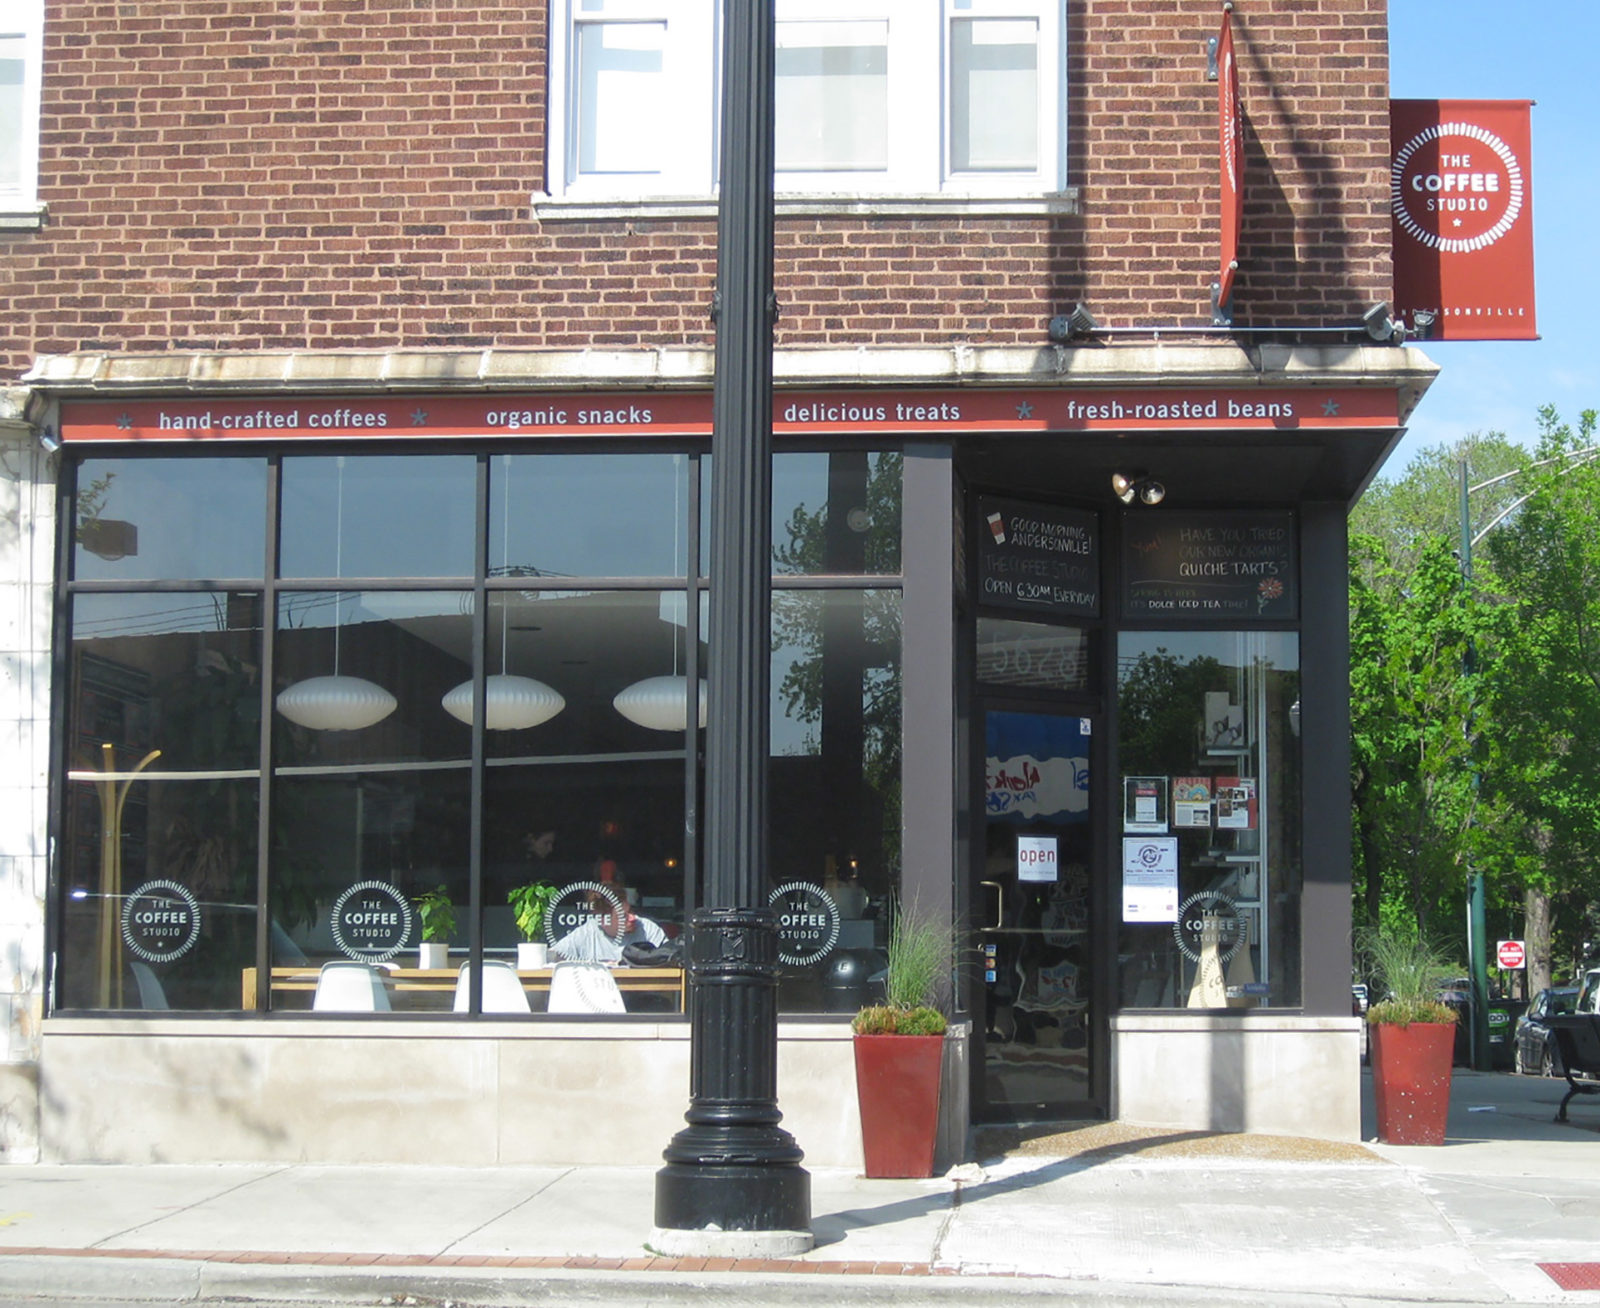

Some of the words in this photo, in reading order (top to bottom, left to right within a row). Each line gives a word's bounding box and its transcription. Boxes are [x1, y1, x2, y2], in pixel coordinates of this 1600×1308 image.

[1441, 154, 1471, 168] THE
[1412, 173, 1499, 192] COFFEE
[1426, 198, 1489, 211] STUDIO
[784, 402, 887, 423] delicious
[896, 401, 961, 421] treats
[1067, 399, 1219, 420] fresh-roasted
[1228, 399, 1294, 418] beans
[158, 409, 299, 431] hand-crafted
[308, 408, 388, 428] coffees
[486, 406, 568, 429] organic
[577, 405, 653, 425] snacks
[1180, 528, 1217, 542] HAVE
[1220, 528, 1245, 542] YOU
[1208, 545, 1234, 558] NEW
[1179, 562, 1229, 577] QUICHE
[984, 576, 1013, 594] OPEN
[1053, 586, 1096, 608] EVERYDAY
[1202, 599, 1221, 609] TEA
[1020, 849, 1055, 867] open
[152, 900, 171, 909] THE
[362, 901, 381, 910] THE
[576, 902, 595, 911] THE
[790, 901, 809, 912] THE
[135, 912, 187, 925] COFFEE
[345, 913, 398, 925] COFFEE
[1201, 909, 1219, 917] THE
[781, 914, 826, 927] OFFEE
[1185, 919, 1235, 931] COFFEE
[142, 928, 181, 937] STUDIO
[352, 928, 391, 938] STUDIO
[779, 930, 820, 940] STUDIO
[1193, 933, 1229, 942] STUDIO
